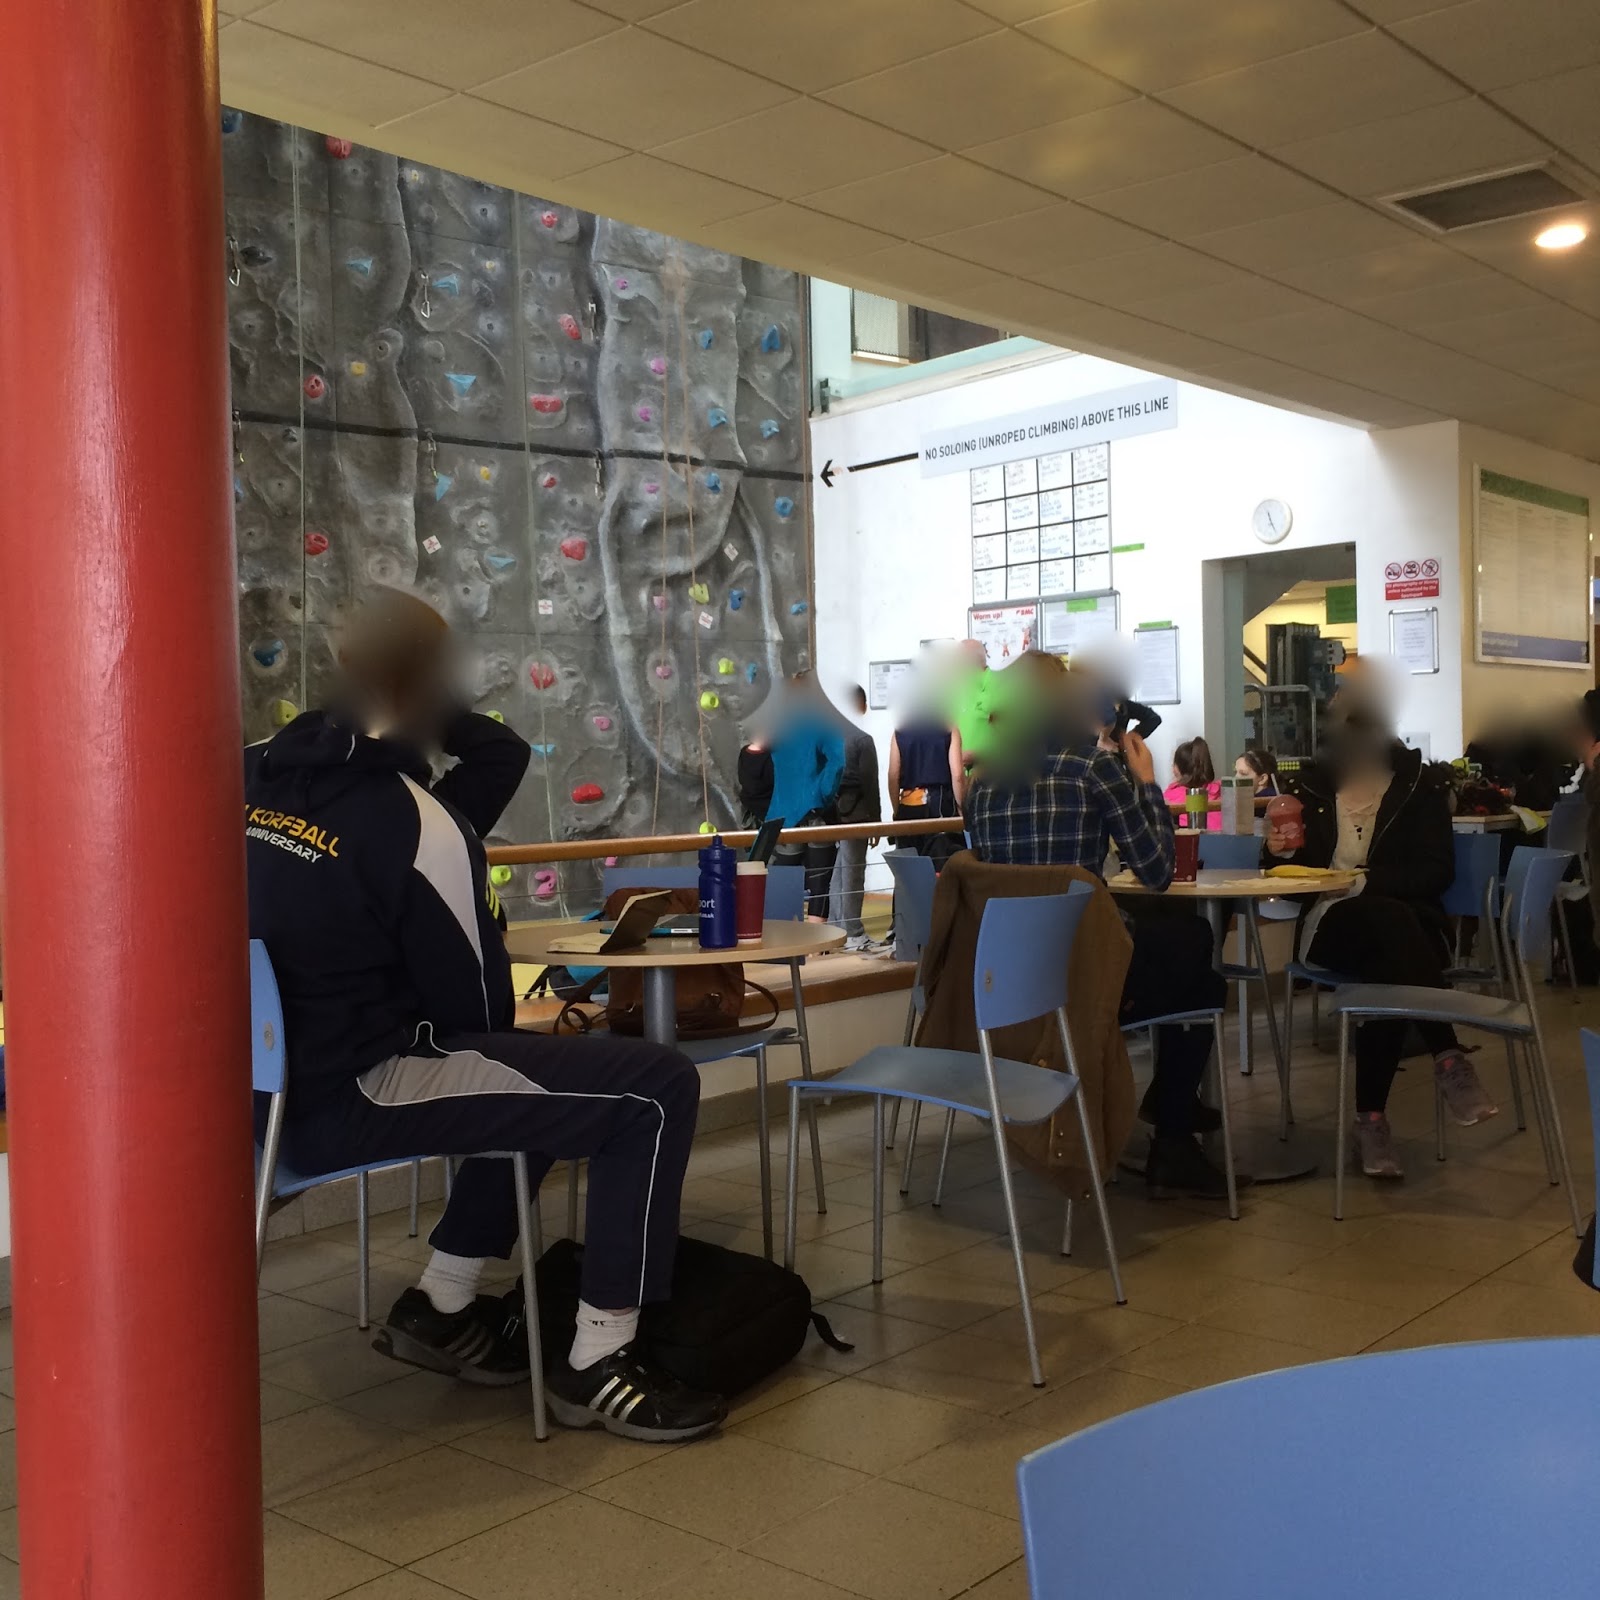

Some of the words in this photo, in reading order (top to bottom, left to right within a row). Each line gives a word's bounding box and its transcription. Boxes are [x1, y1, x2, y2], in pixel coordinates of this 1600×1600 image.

[925, 447, 938, 461] NO
[939, 439, 977, 458] SOLOING
[1081, 408, 1115, 428] ABOVE
[1117, 402, 1141, 420] THIS
[1144, 396, 1169, 415] LINE
[248, 807, 340, 858] KORFBALL
[699, 898, 716, 909] ort
